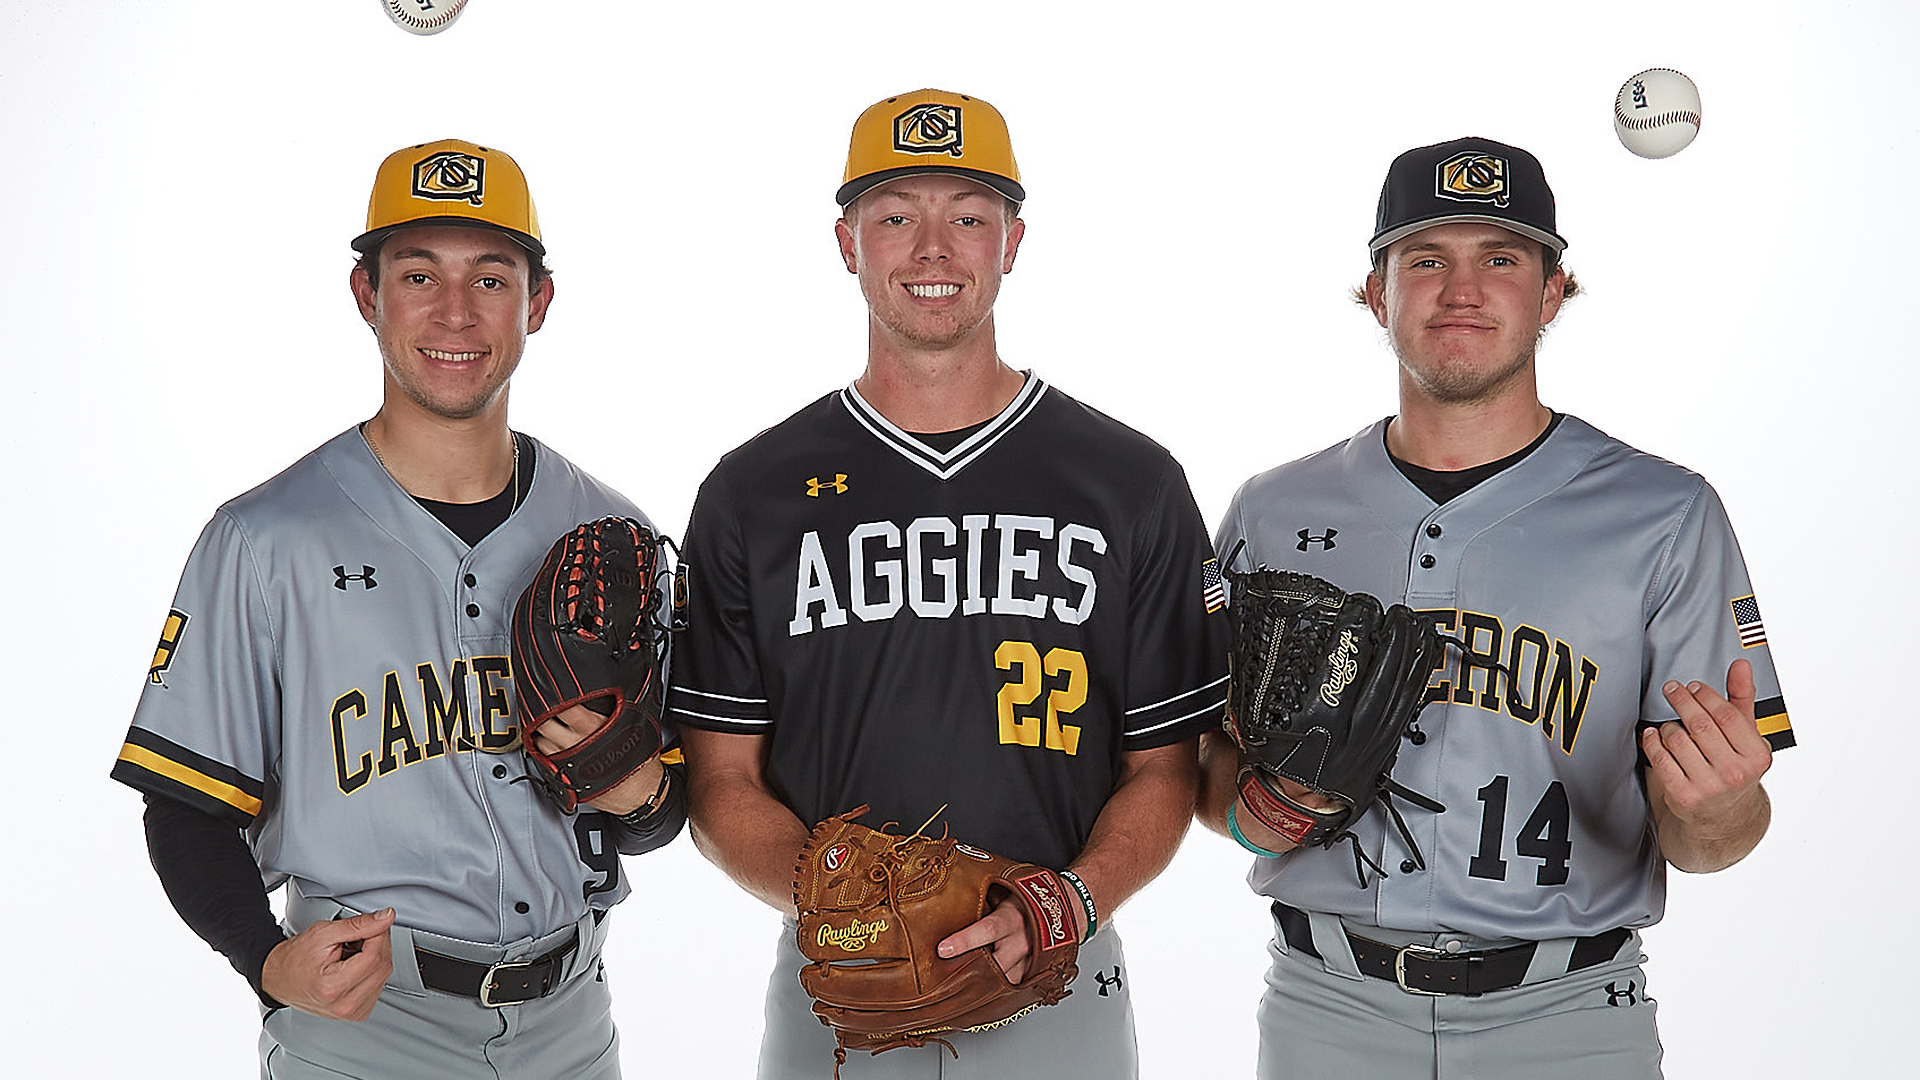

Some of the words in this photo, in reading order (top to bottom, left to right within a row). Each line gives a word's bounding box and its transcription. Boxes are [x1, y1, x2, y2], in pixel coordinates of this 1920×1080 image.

[789, 513, 1108, 637] AGGIES
[994, 640, 1089, 756] 22
[1319, 628, 1359, 707] Rawlings
[328, 654, 518, 797] CAME
[573, 812, 619, 905] 9
[1467, 774, 1574, 887] 14
[816, 918, 890, 947] Rawlings
[1029, 881, 1066, 940] Rawlings
